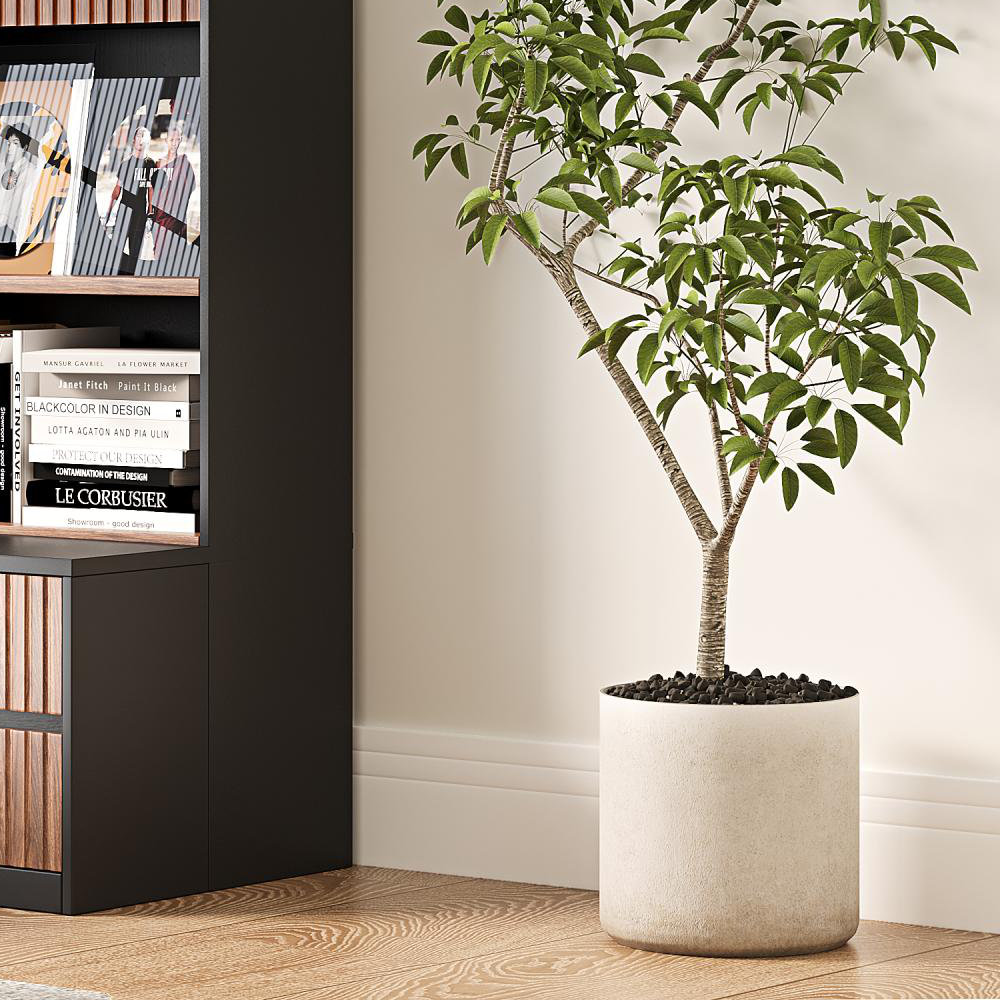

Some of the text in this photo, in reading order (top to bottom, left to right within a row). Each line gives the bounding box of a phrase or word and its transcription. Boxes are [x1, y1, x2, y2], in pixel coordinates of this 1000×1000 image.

[58, 379, 177, 393] Janet Fitch Paint It Black
[26, 401, 151, 416] BLACKCOLOR IN DESIGN
[48, 425, 170, 439] LOTTA AGATON AND PIA ULIN
[52, 448, 163, 465] PROTECT OUR DESIGN
[55, 467, 148, 482] CONTAMINATION OF THE DESIGN
[55, 487, 168, 509] LE CORBUSIER
[67, 518, 105, 526] Showroom
[111, 520, 130, 528] good
[132, 519, 155, 529] design
